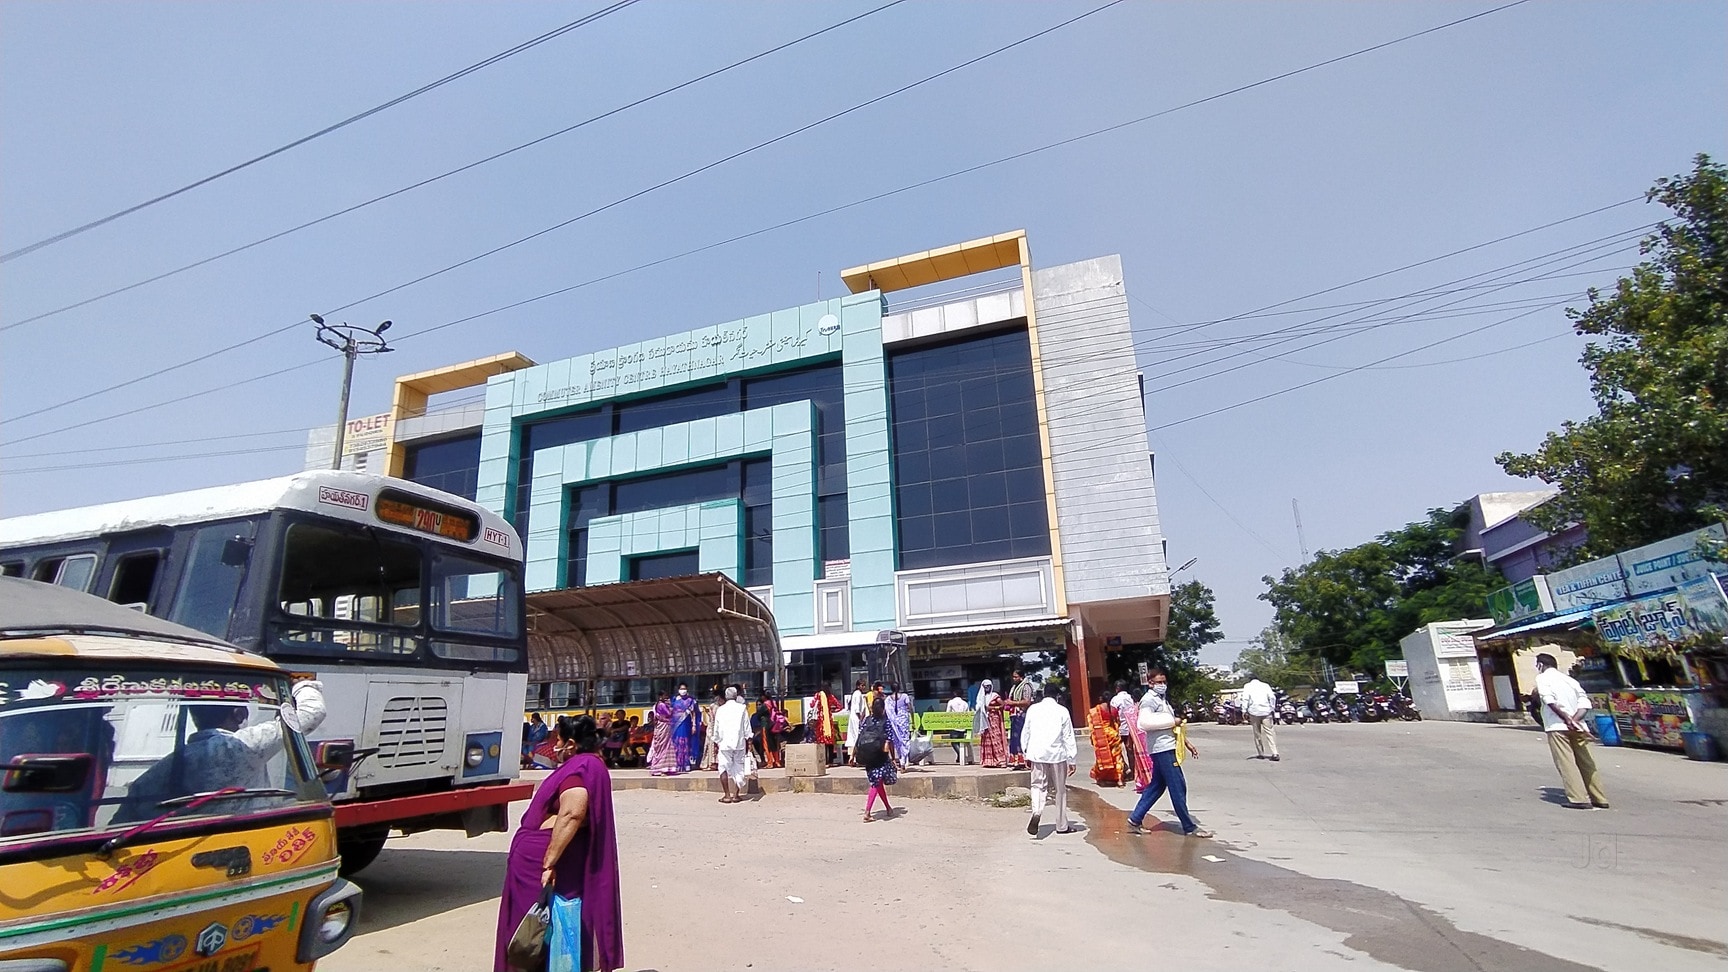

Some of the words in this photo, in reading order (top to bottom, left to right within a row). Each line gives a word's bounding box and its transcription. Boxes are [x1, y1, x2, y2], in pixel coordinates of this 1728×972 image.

[537, 384, 582, 403] COMMUTER
[583, 375, 622, 394] AMENITY
[347, 413, 391, 435] TO-LET
[486, 530, 507, 546] HYT-1
